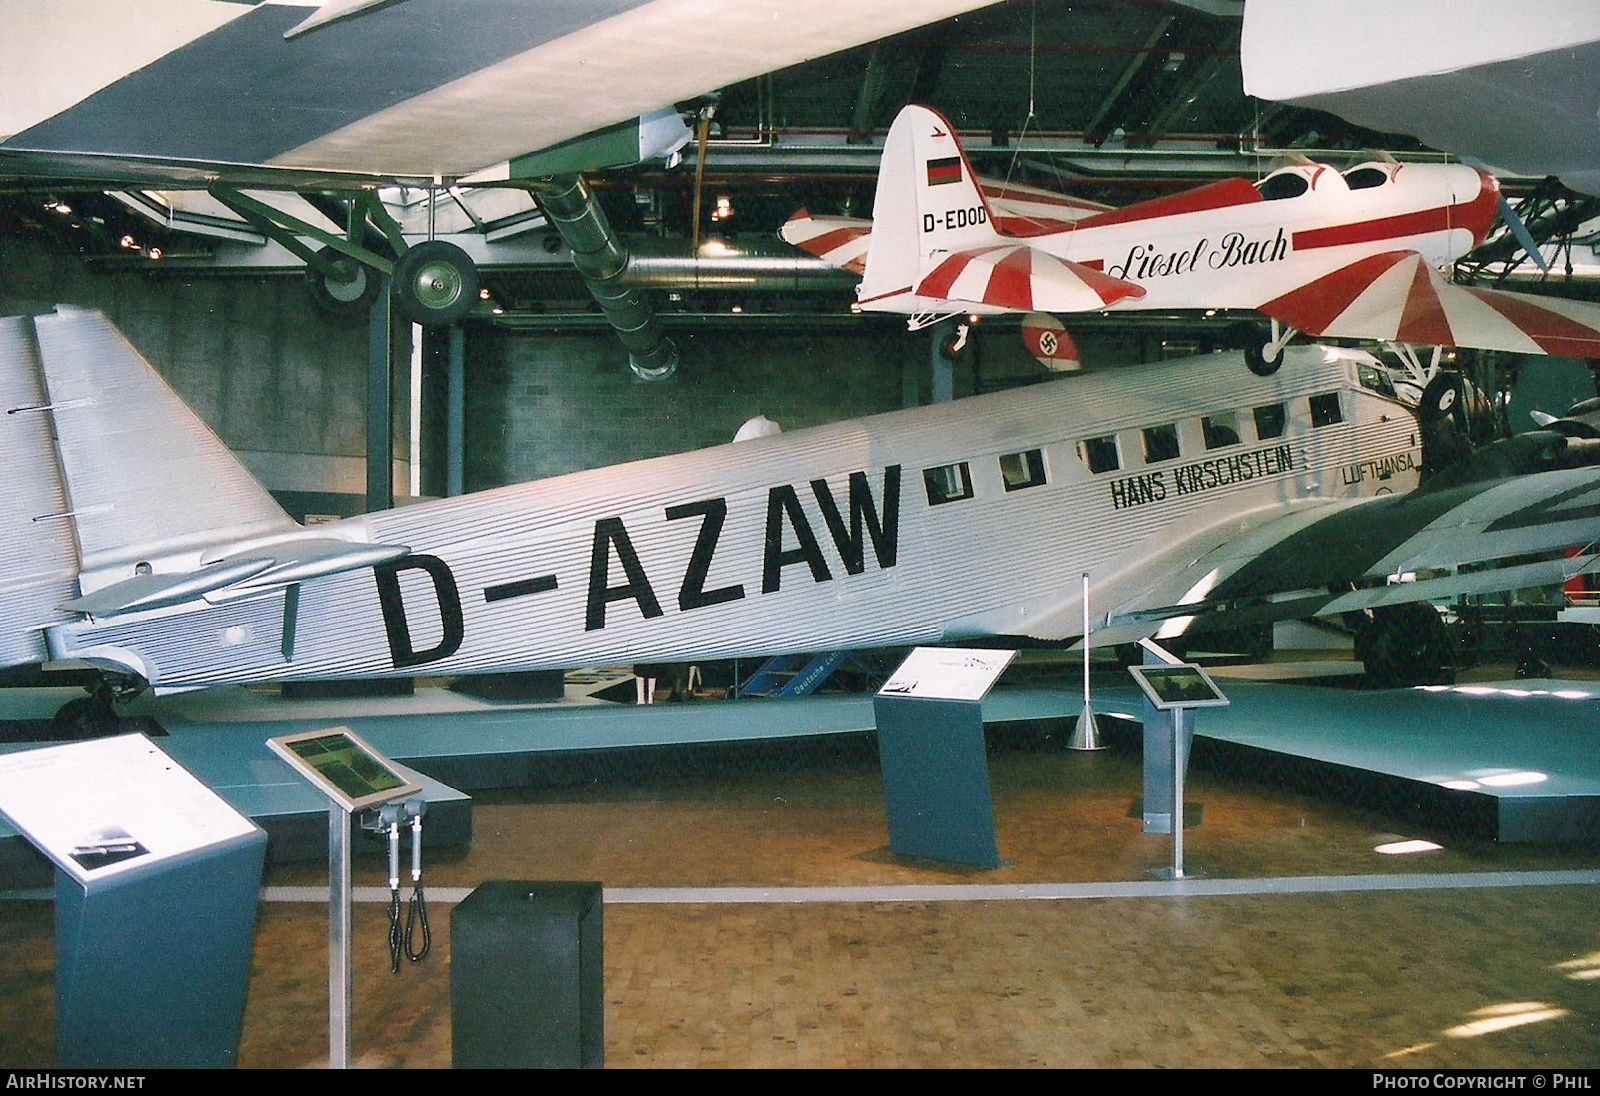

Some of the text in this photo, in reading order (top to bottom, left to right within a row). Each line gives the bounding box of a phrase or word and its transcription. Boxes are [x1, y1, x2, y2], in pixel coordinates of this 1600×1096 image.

[923, 206, 987, 233] D-EDOD
[1108, 227, 1288, 281] Liesel Bach
[1110, 444, 1294, 510] HANS KIRSCHSTEIN
[1342, 453, 1416, 486] LUFTHANSA
